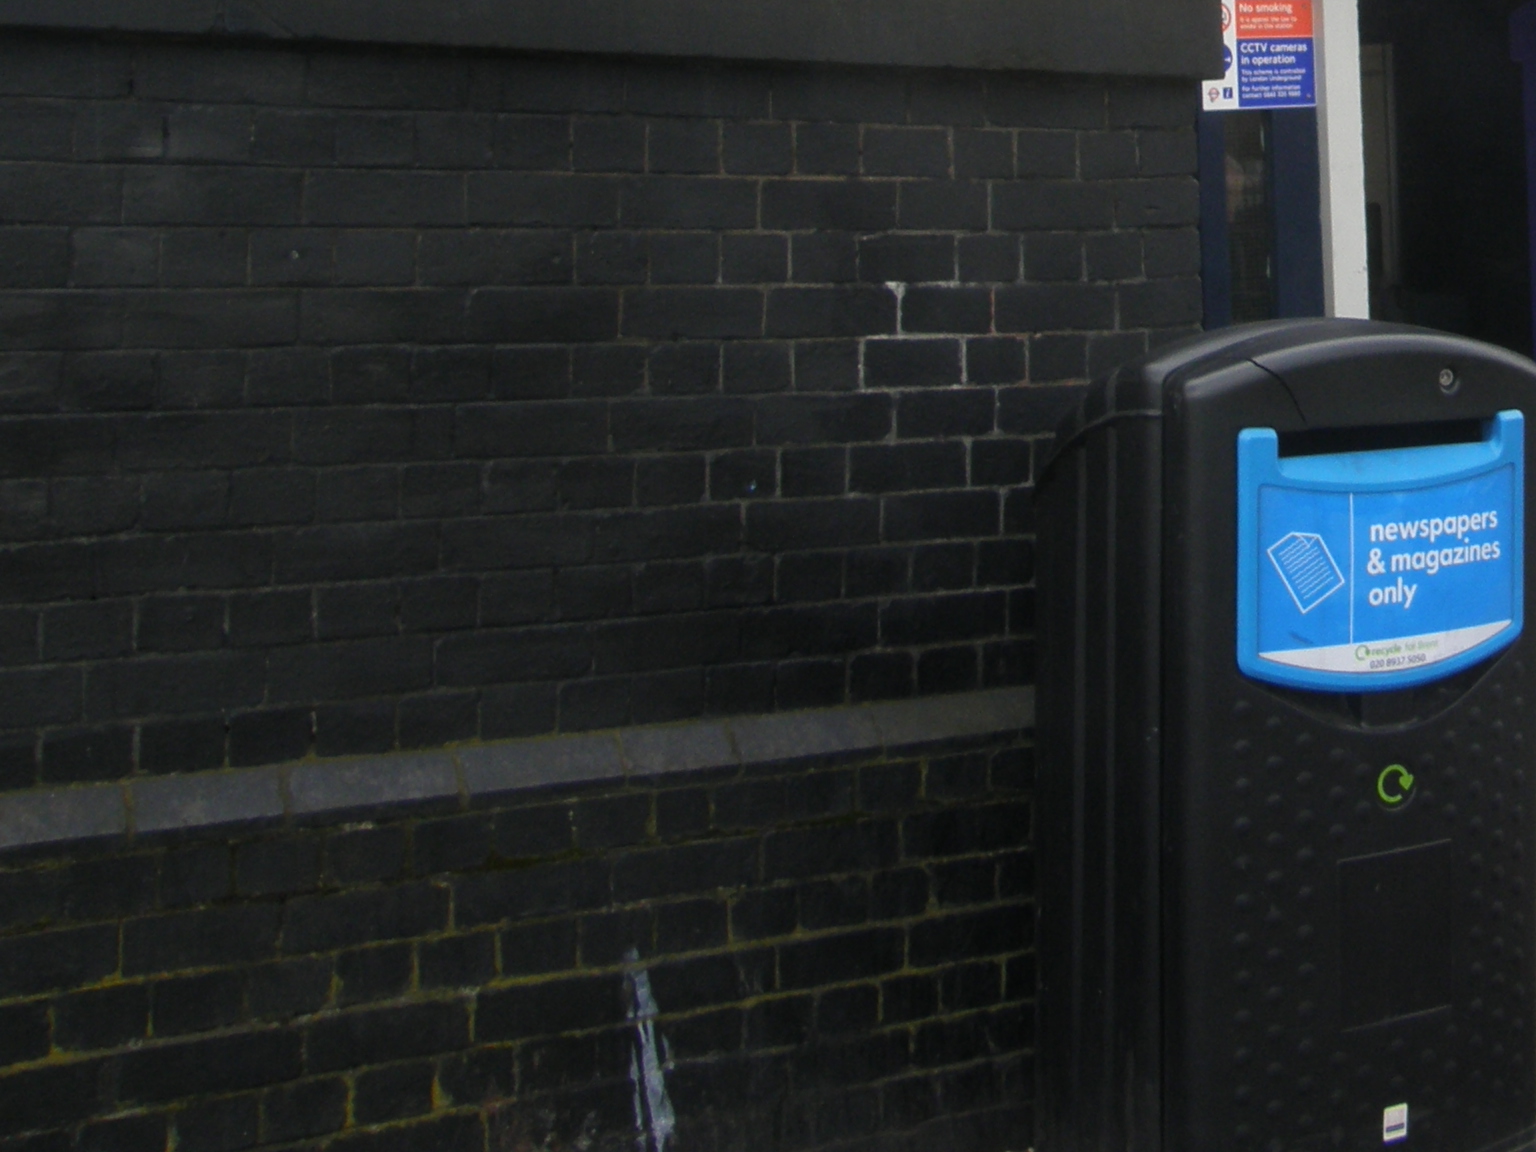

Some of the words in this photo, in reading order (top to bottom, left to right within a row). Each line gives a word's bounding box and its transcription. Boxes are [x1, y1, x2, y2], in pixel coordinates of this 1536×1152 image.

[1239, 3, 1253, 13] No
[1256, 2, 1293, 14] smoking
[1240, 43, 1268, 53] CCTV
[1270, 43, 1307, 53] cameras
[1241, 55, 1249, 65] in
[1252, 54, 1296, 66] operation
[1370, 510, 1498, 542] newspapers
[1367, 549, 1386, 575] &
[1390, 538, 1500, 576] magazines
[1368, 577, 1418, 608] only
[1371, 644, 1402, 656] recycle
[1369, 660, 1385, 669] 020
